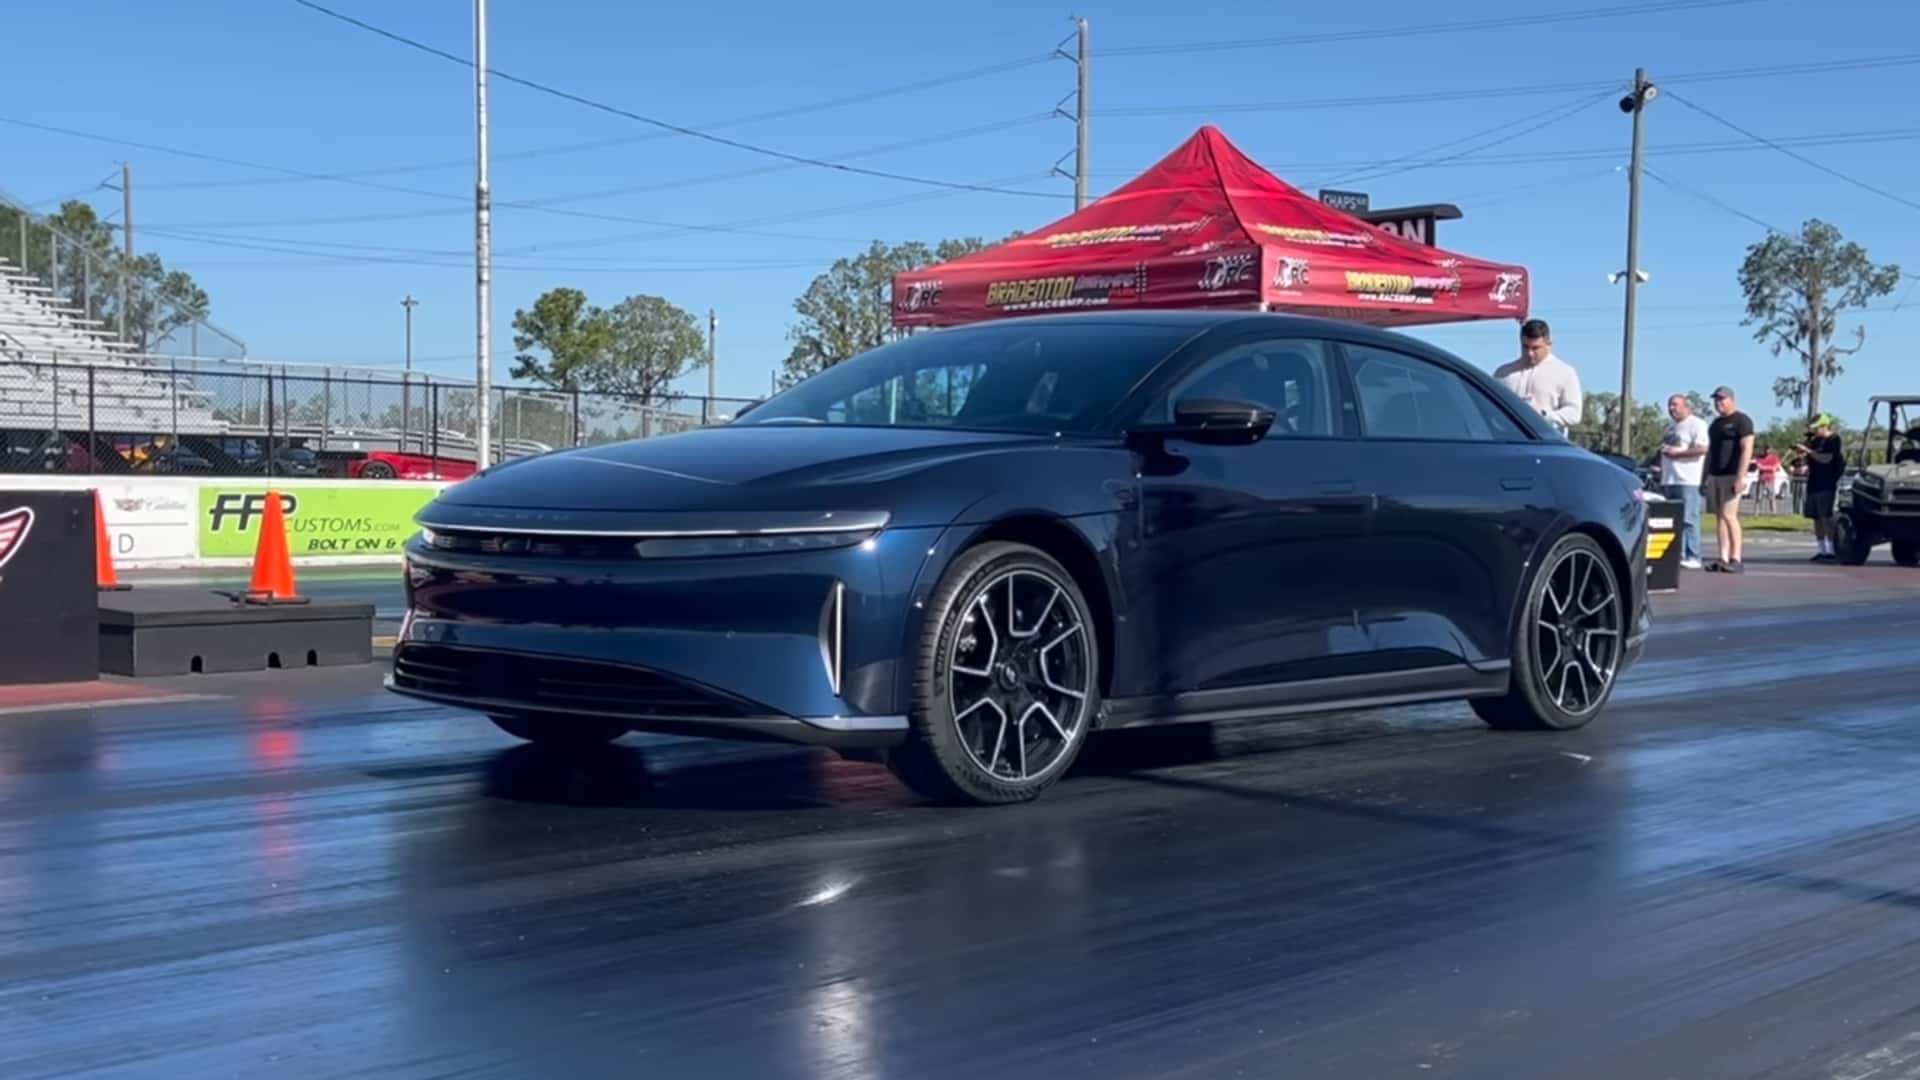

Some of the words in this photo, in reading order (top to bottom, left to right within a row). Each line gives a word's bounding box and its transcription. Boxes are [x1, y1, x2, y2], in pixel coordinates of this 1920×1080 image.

[986, 275, 1076, 306] BRADENTON
[307, 537, 352, 551] BOLT
[355, 537, 381, 550] ON
[386, 537, 397, 550] &
